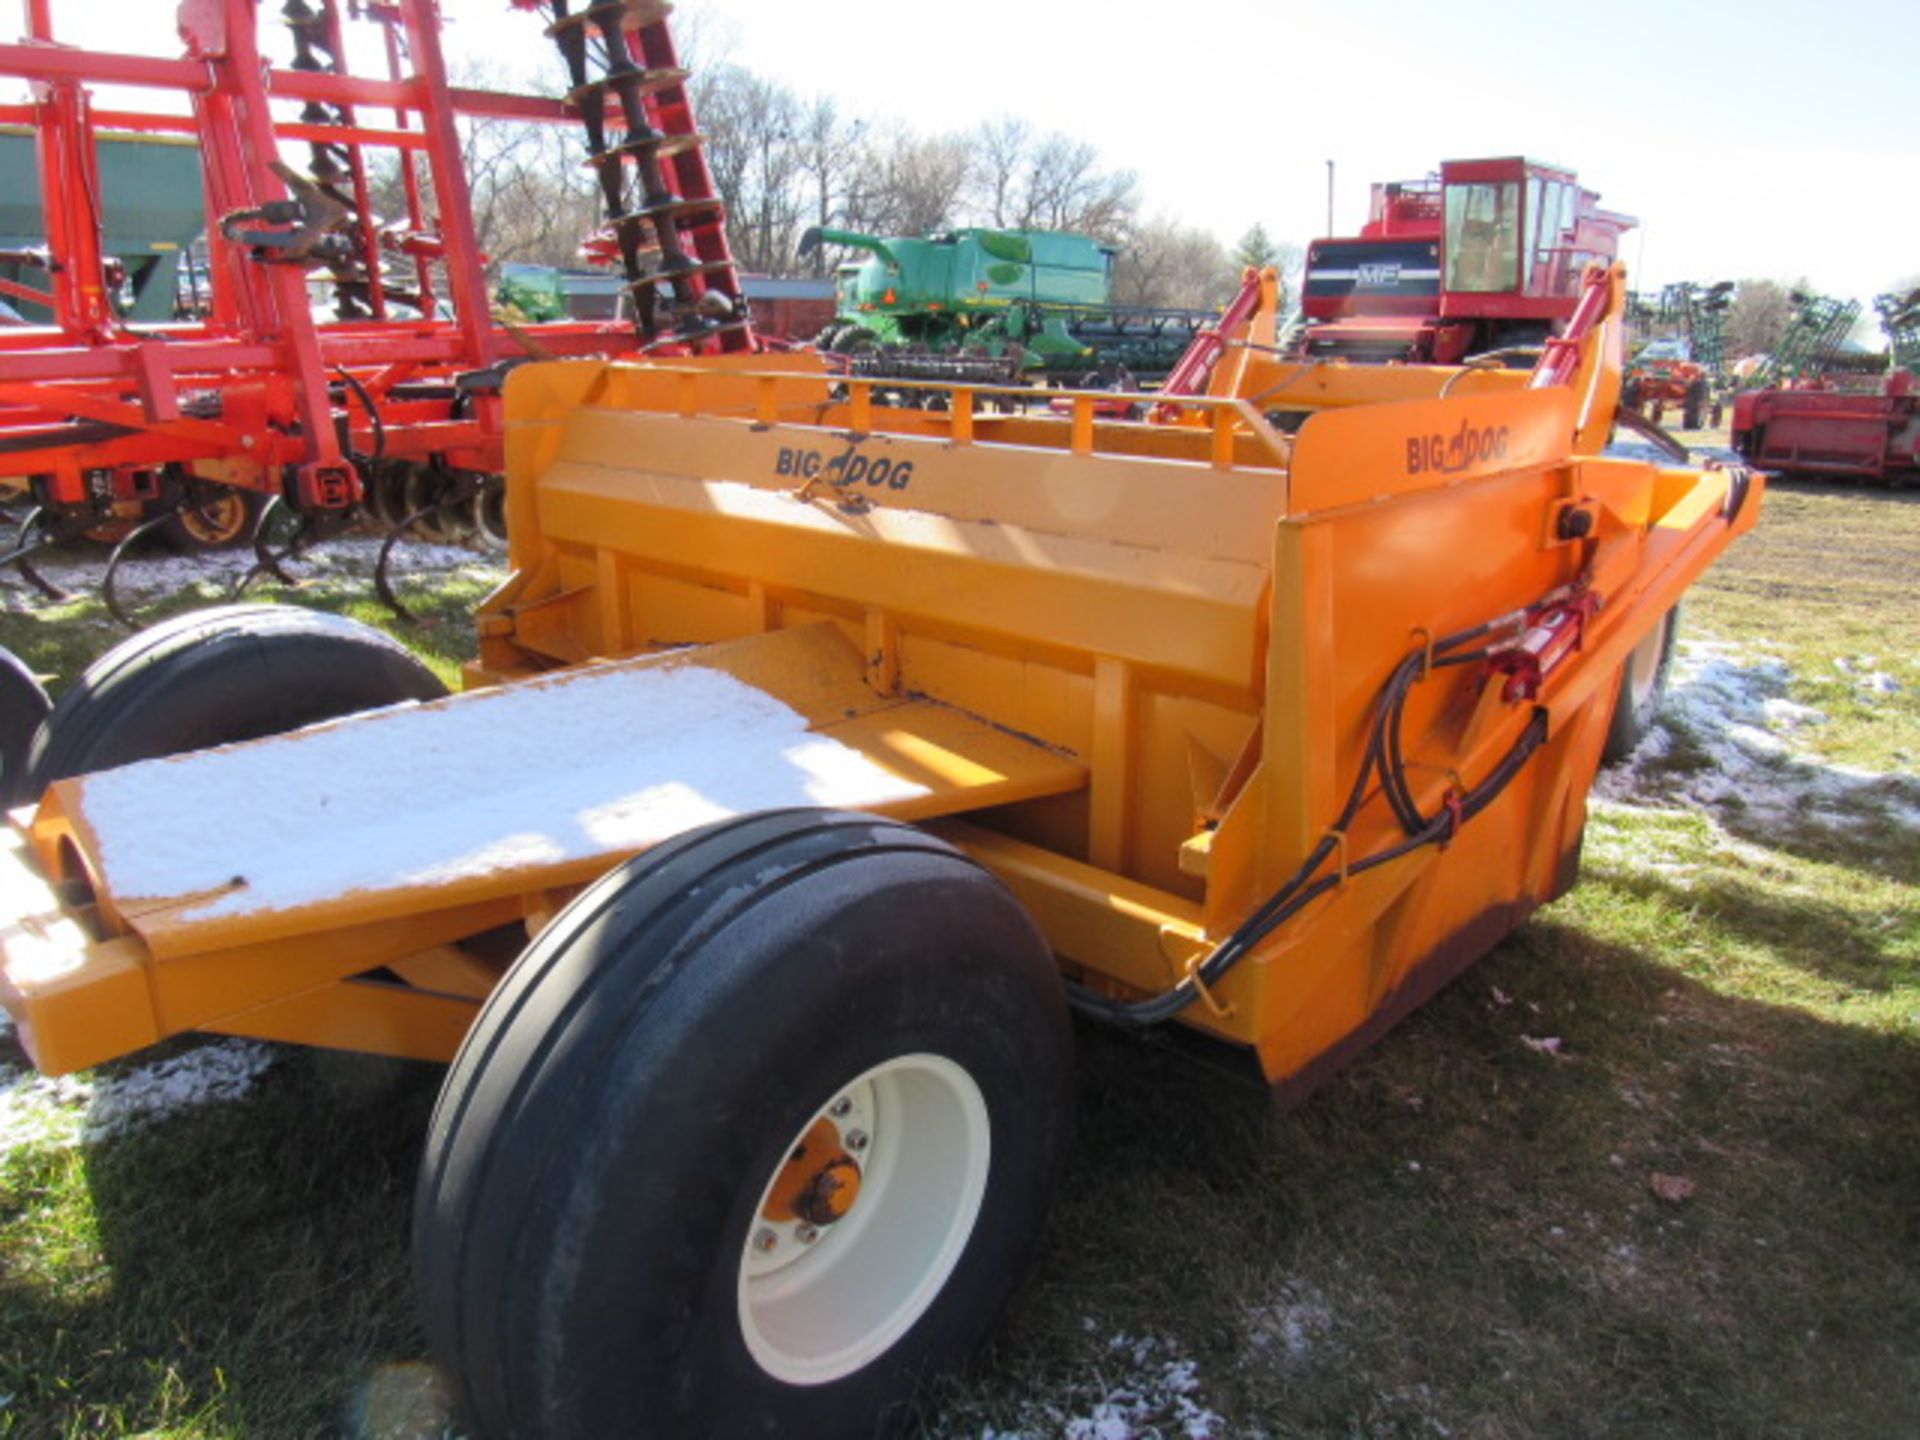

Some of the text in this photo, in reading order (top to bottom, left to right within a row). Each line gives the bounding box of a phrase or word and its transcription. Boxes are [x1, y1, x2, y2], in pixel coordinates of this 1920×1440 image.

[776, 448, 913, 490] BIG DOG
[1407, 426, 1509, 474] BIG DOG
